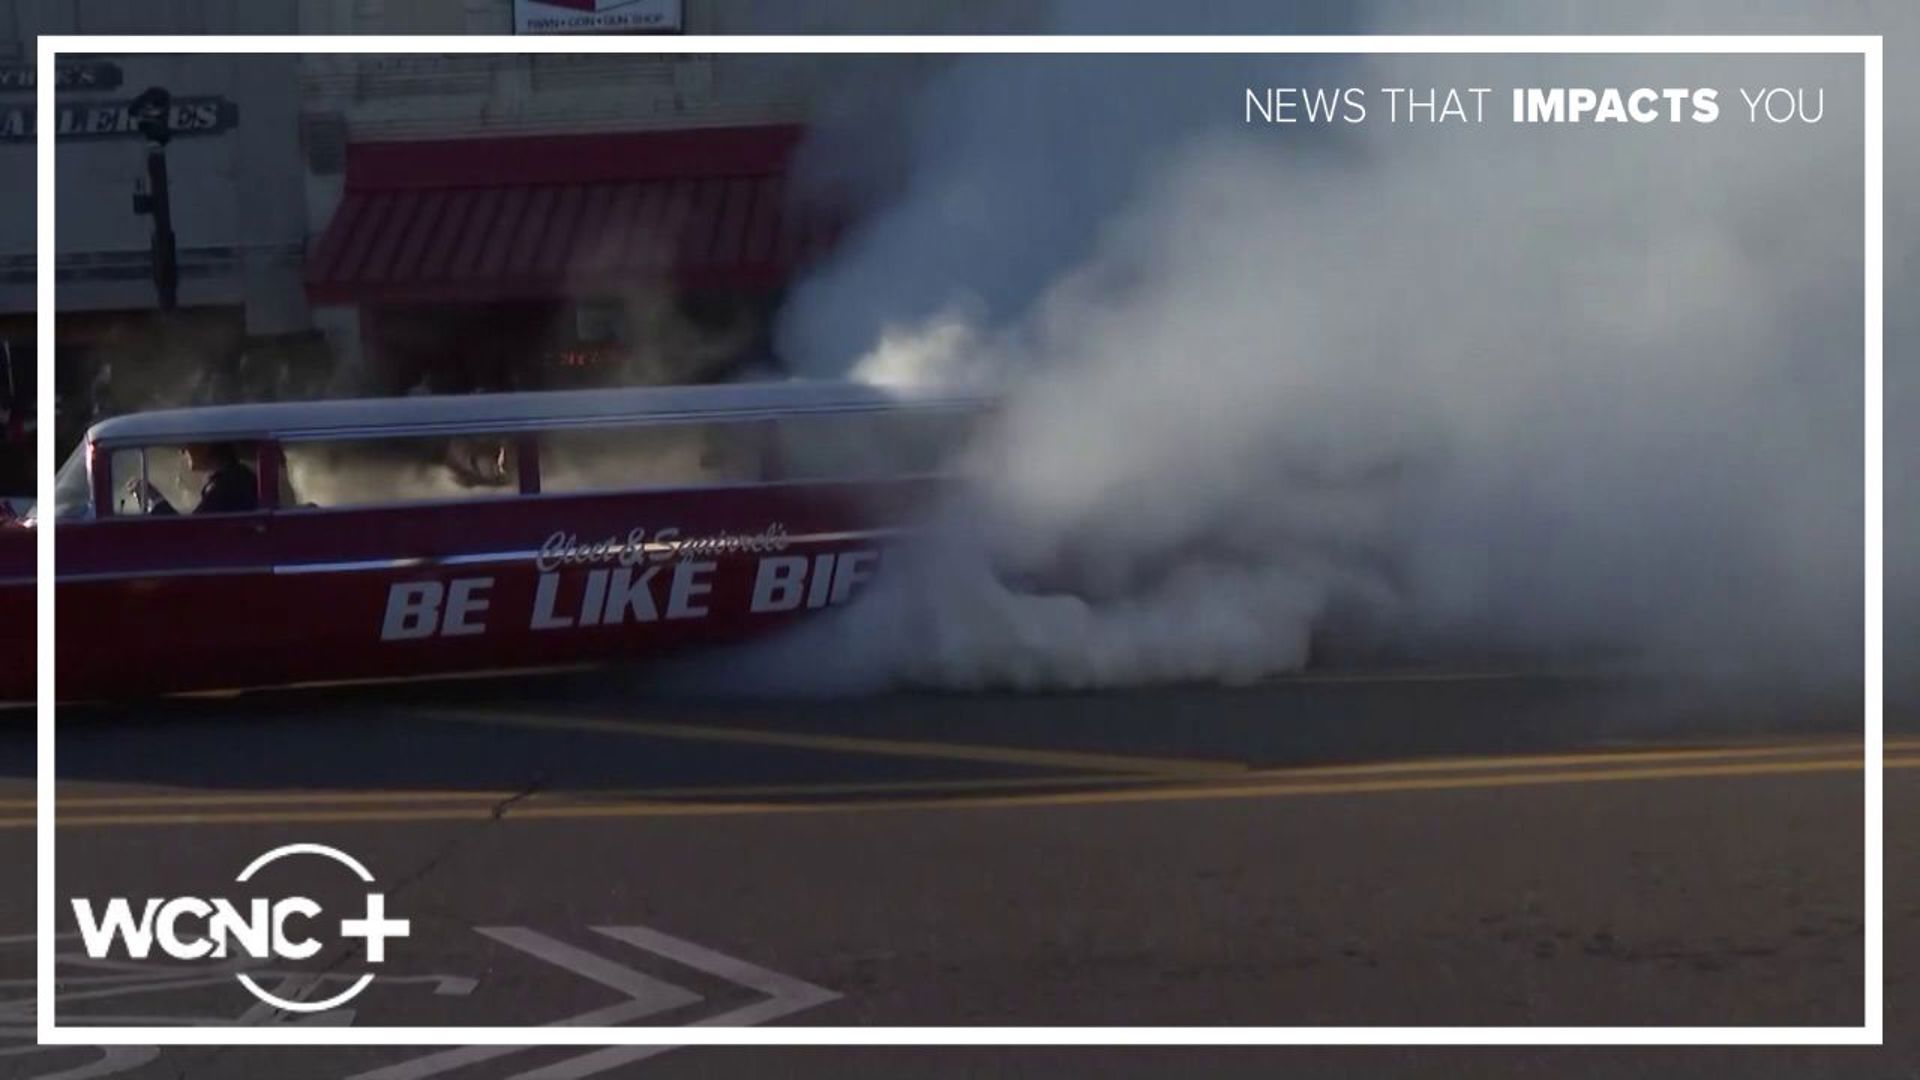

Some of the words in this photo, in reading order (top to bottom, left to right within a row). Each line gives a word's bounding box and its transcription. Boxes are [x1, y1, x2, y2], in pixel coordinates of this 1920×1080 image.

[619, 527, 647, 567] &
[381, 577, 494, 641] BE
[530, 560, 717, 631] LIKE
